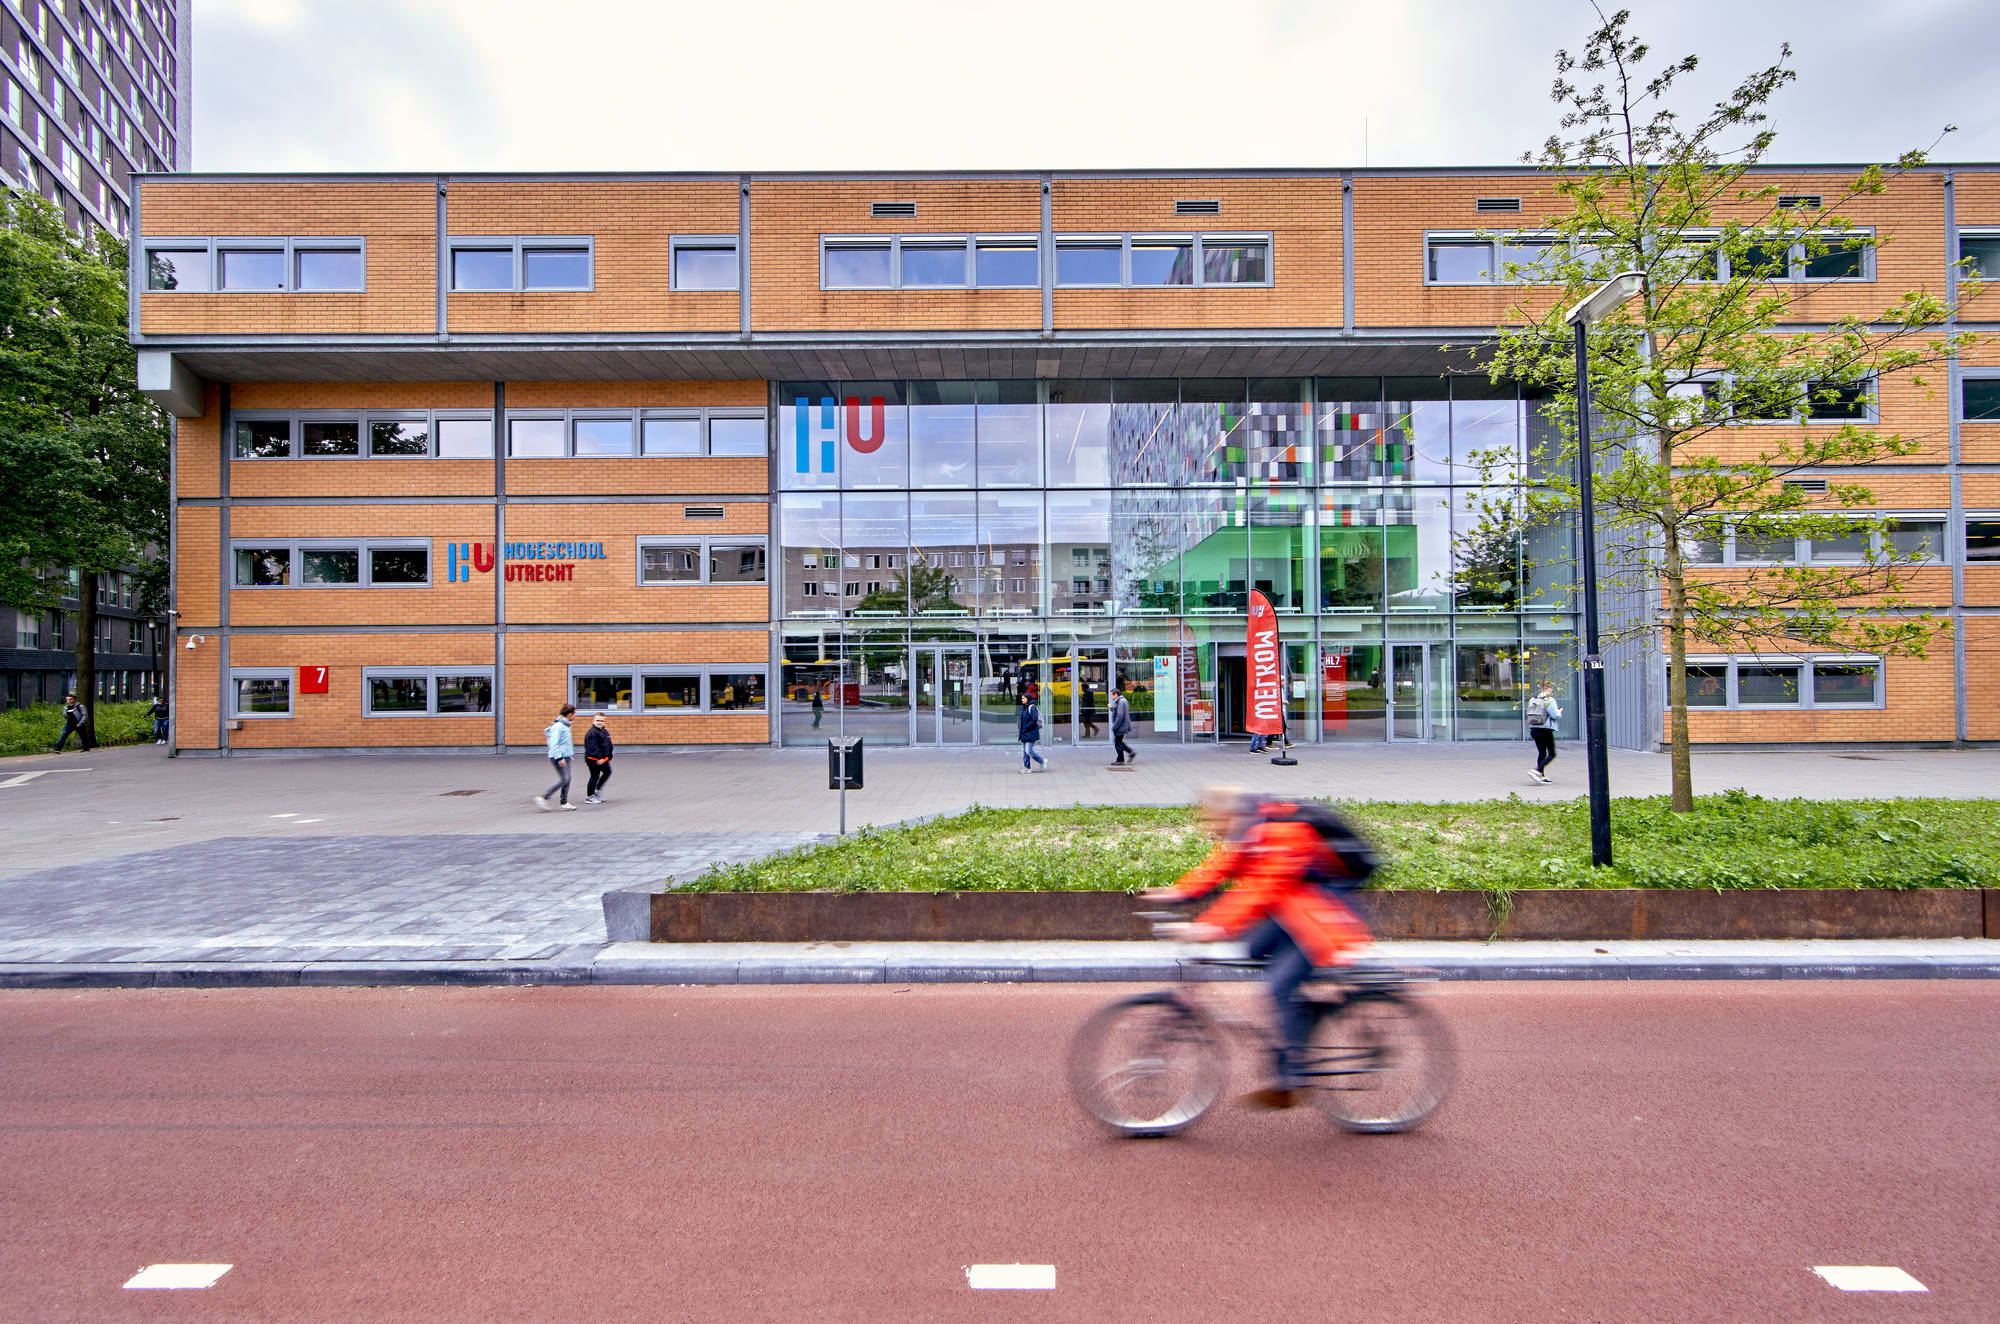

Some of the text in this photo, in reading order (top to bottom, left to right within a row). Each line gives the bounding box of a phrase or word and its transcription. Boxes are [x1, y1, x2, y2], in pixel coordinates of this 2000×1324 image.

[795, 396, 885, 473] HU
[505, 542, 607, 559] HOGESCHOOL
[448, 542, 494, 582] HU
[505, 564, 575, 581] UTRECHT
[1325, 656, 1340, 665] HL7
[316, 667, 326, 684] 7
